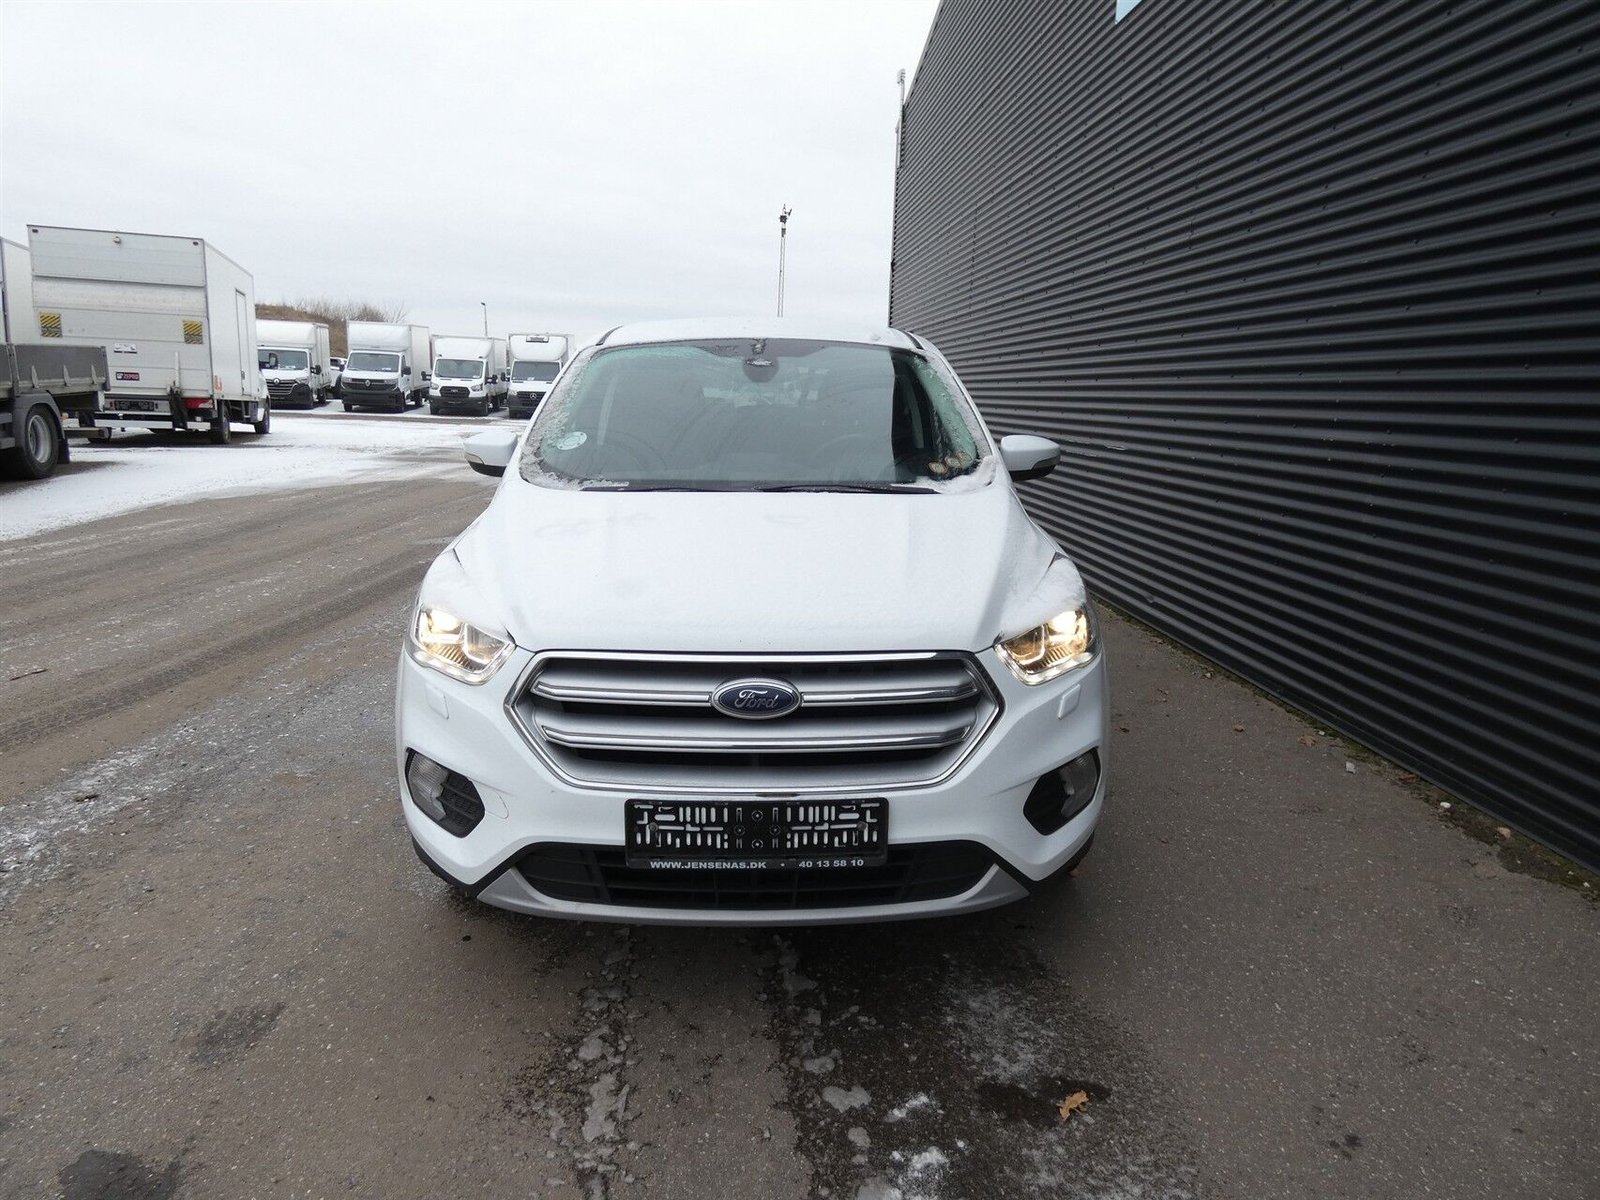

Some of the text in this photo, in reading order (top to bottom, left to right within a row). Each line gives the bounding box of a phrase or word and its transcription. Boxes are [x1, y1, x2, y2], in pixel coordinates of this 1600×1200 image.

[734, 689, 779, 708] Ford
[649, 859, 865, 869] WWW.JENSENAS.DK 40 13 58 10
